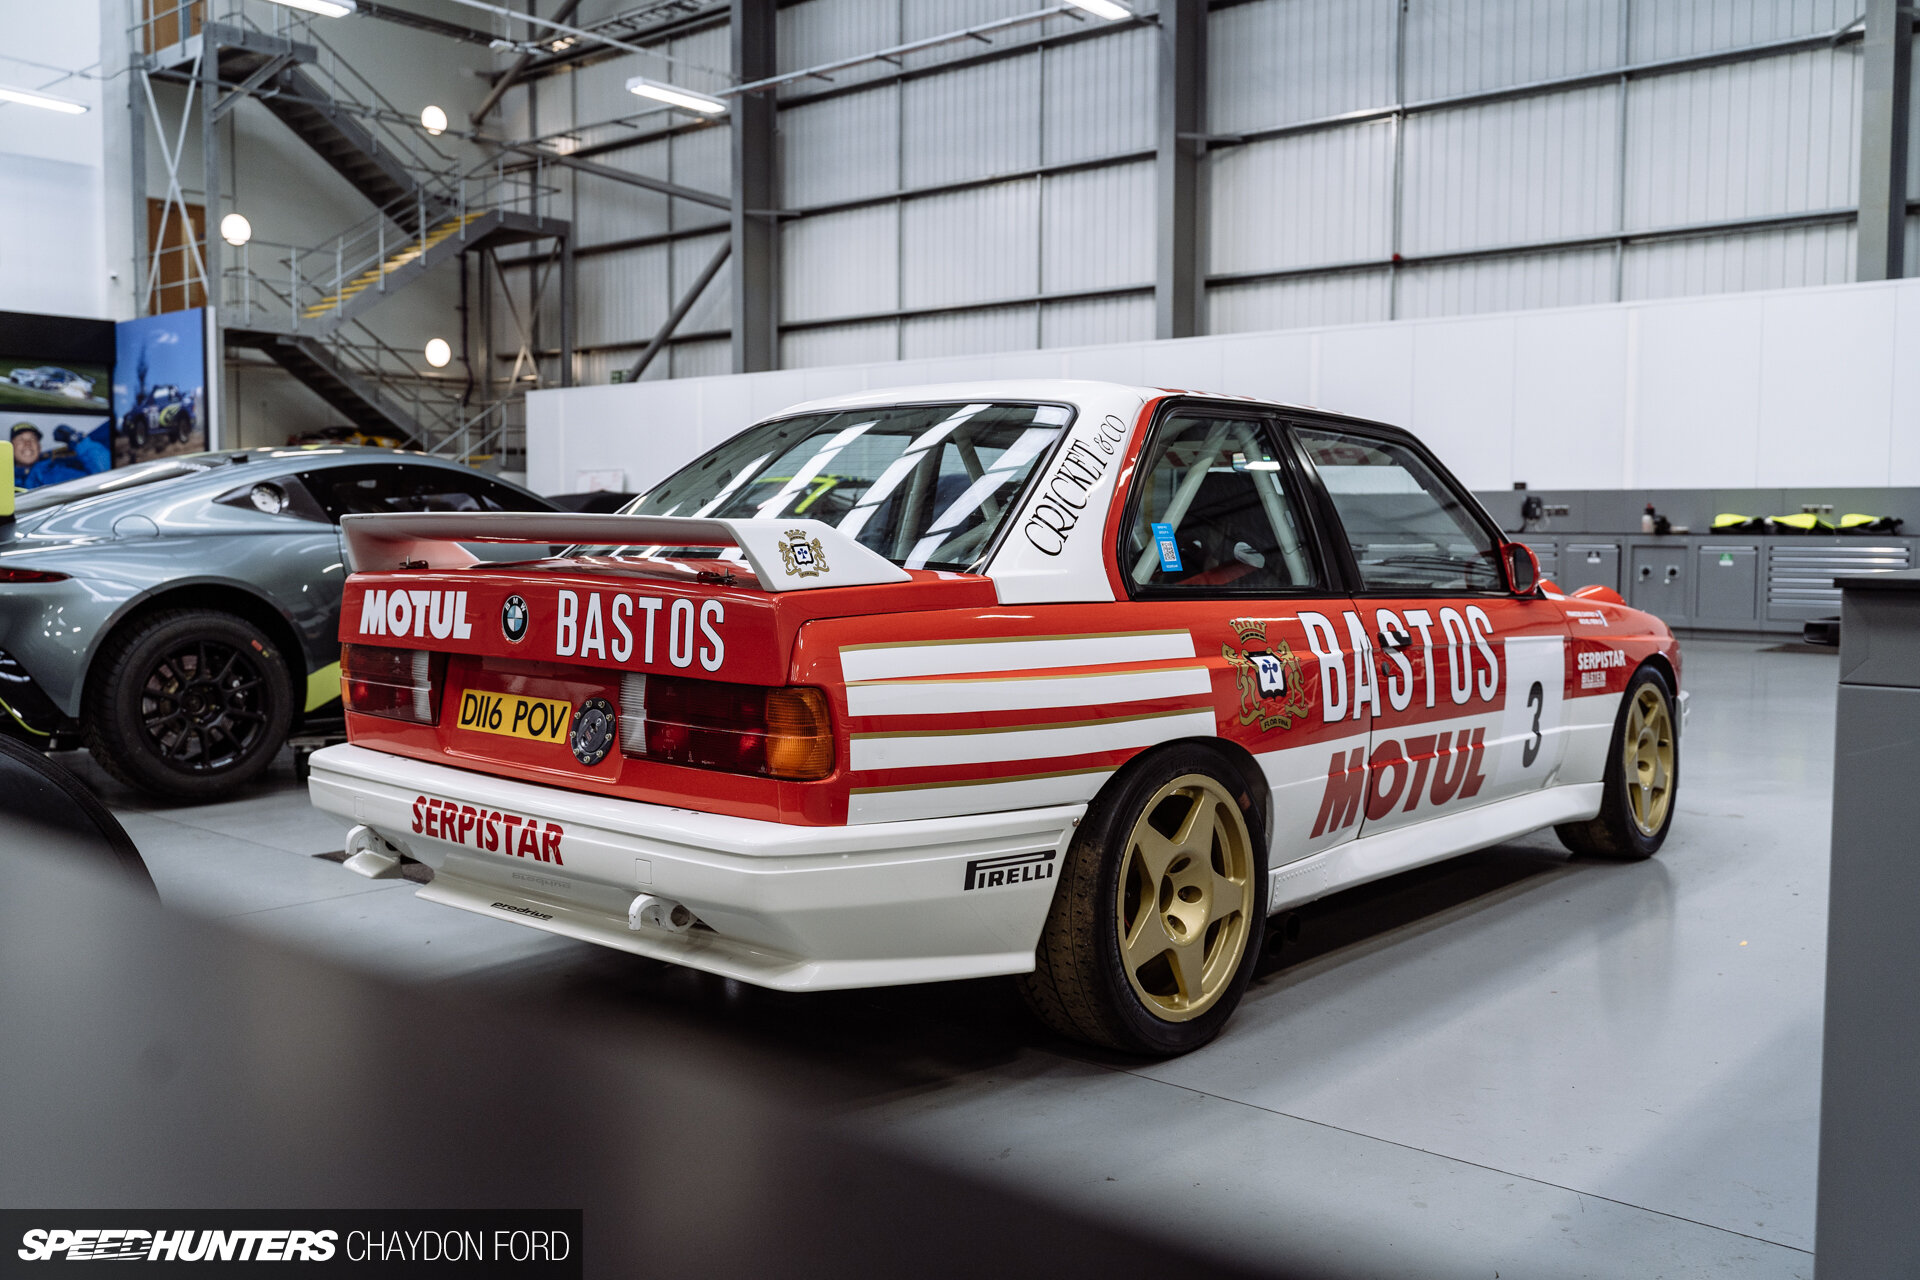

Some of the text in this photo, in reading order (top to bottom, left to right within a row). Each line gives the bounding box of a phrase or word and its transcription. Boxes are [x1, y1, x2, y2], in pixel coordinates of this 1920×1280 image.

[1025, 438, 1108, 556] CRICKET
[360, 589, 472, 640] MOTUL
[556, 589, 726, 672] BASTOS
[1297, 604, 1500, 723] BASTOS
[1578, 650, 1626, 670] SERPISTAR
[461, 692, 569, 740] D116 POV
[1522, 681, 1544, 768] 3
[1310, 727, 1487, 839] MOTUL
[412, 796, 564, 865] SERPISTAR
[964, 850, 1056, 890] PIRELLI
[491, 902, 553, 920] prodrive
